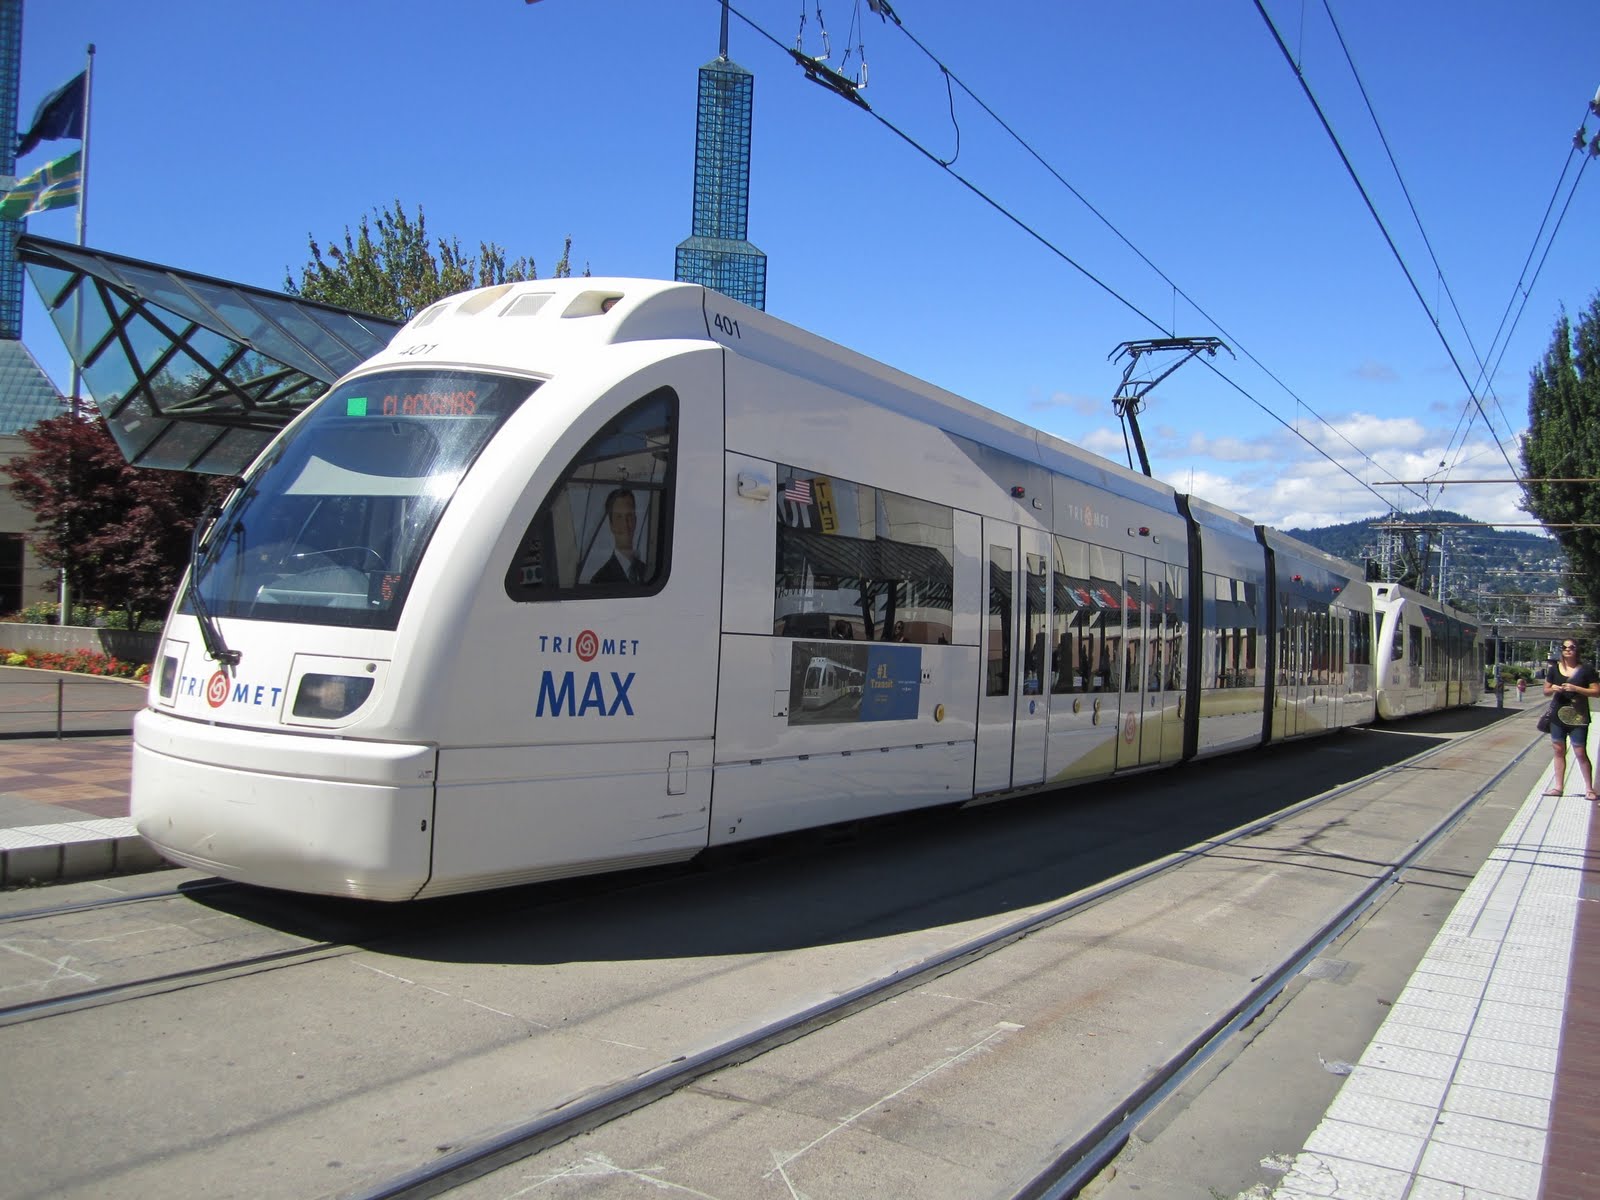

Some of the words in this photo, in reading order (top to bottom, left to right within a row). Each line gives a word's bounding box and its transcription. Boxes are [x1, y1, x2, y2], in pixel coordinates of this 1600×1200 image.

[714, 313, 741, 339] 401
[400, 343, 438, 356] 401
[535, 670, 636, 718] MAX
